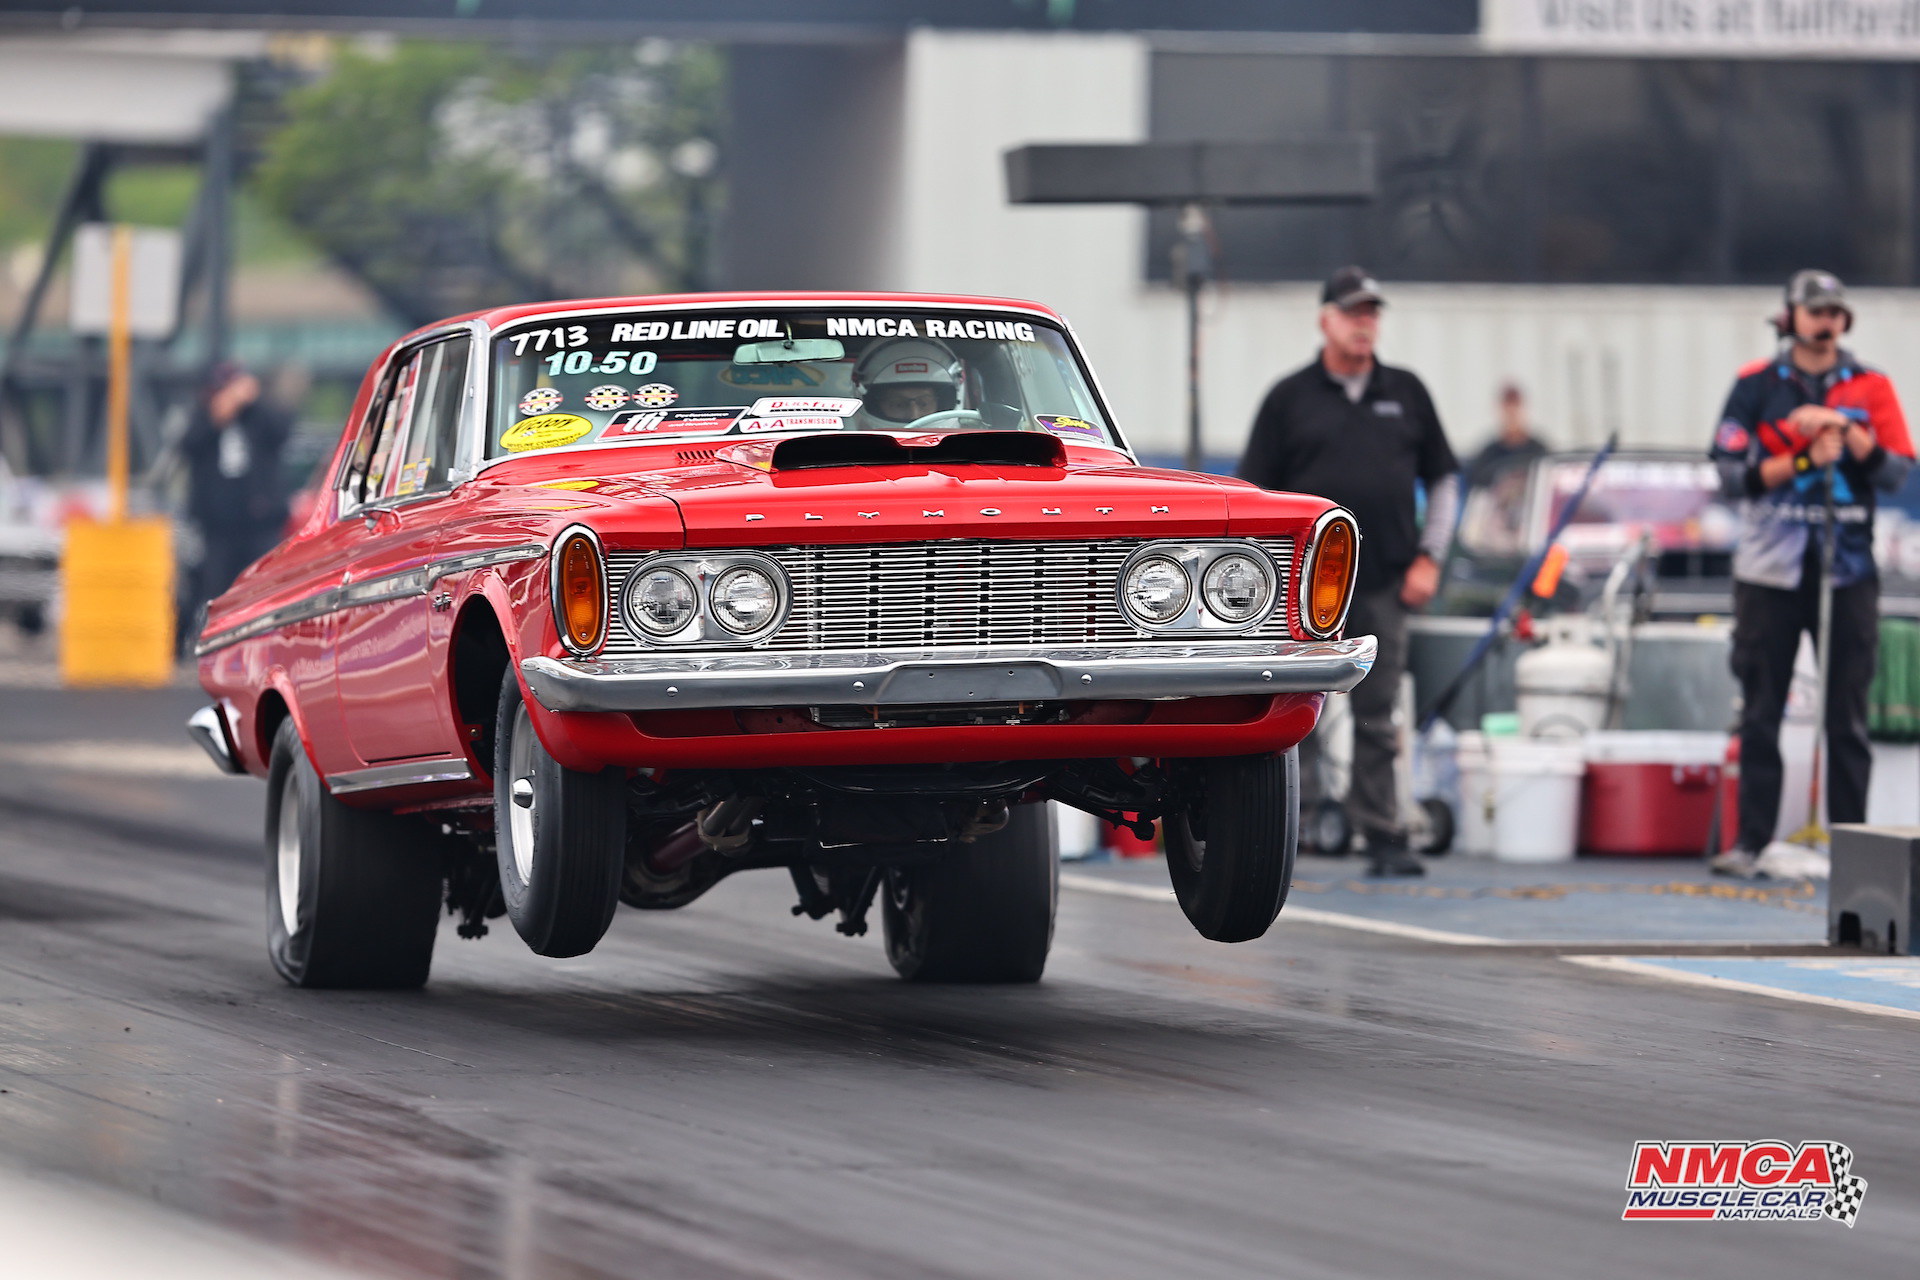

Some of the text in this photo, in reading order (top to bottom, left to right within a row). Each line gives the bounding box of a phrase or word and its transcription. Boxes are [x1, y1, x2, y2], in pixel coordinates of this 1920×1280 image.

[509, 326, 590, 356] 7713
[611, 319, 785, 342] RED LINE OIL
[826, 317, 1036, 342] NMCA RACING
[545, 351, 658, 376] 10.50
[745, 505, 1170, 522] PLYMOUTH
